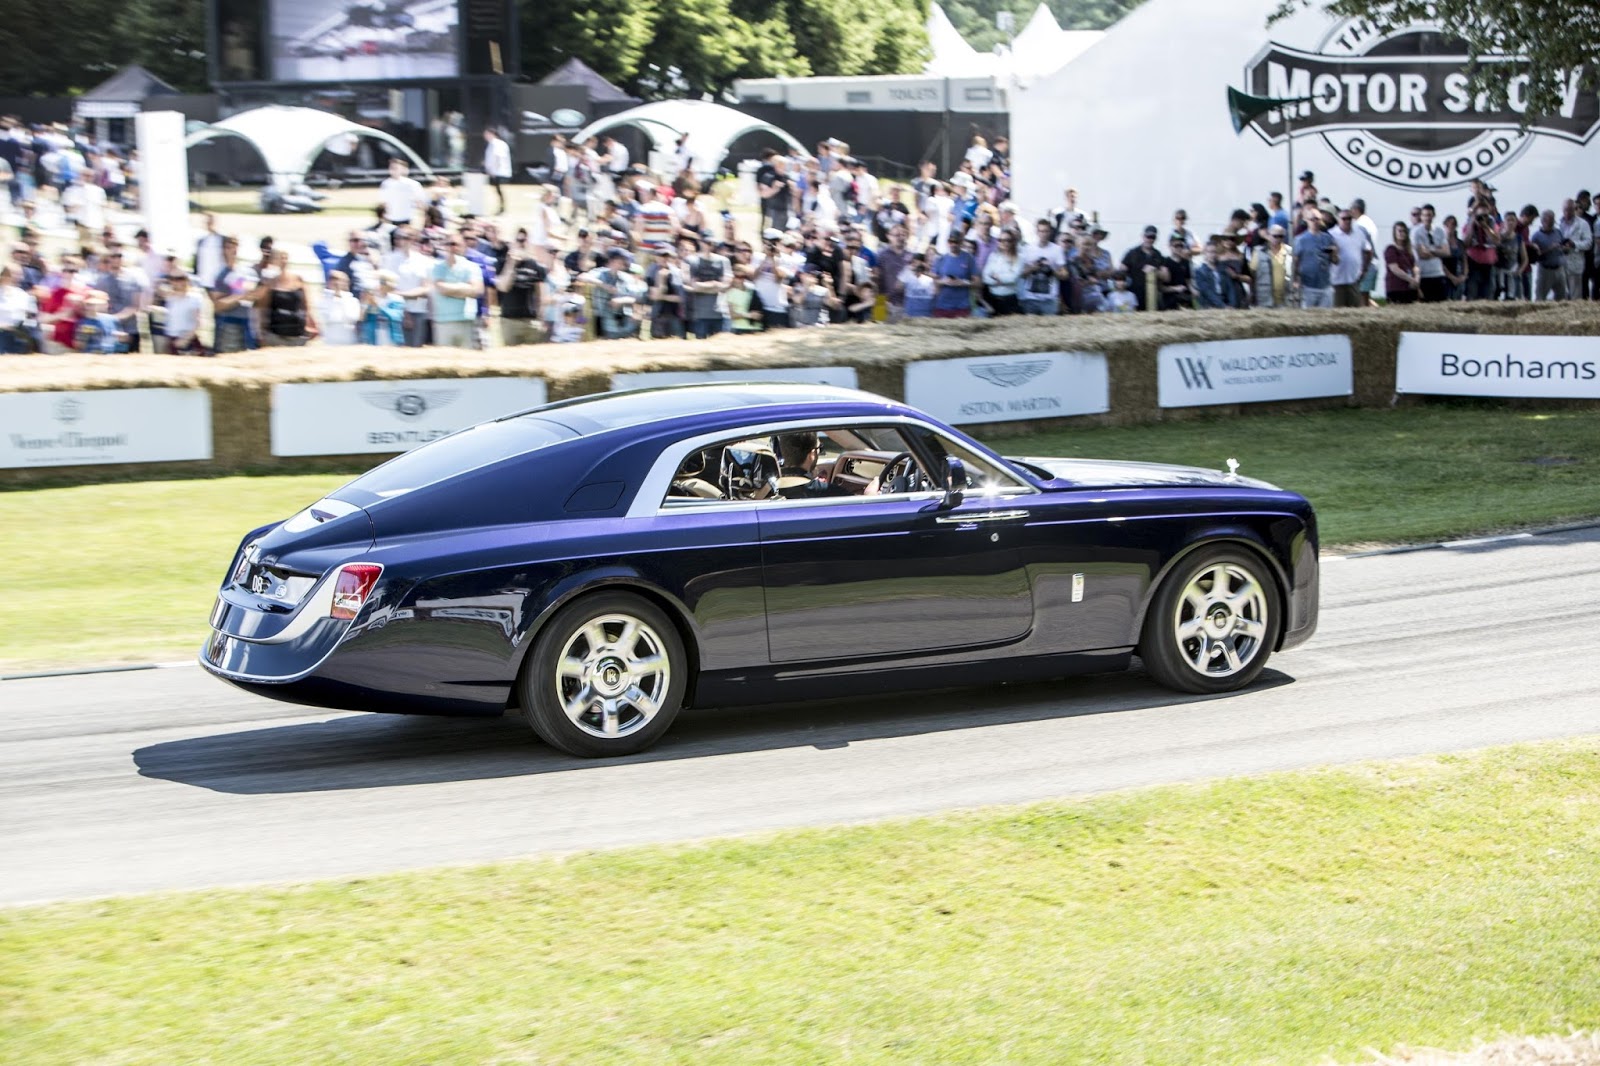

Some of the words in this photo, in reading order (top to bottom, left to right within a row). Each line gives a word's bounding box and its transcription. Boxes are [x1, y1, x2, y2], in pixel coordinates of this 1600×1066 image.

[1267, 60, 1428, 124] MOTOR
[1347, 137, 1511, 180] GOODWOOD
[1219, 354, 1287, 371] WALDORF
[1287, 351, 1337, 368] ASTORIA
[1441, 353, 1597, 380] Bonhams
